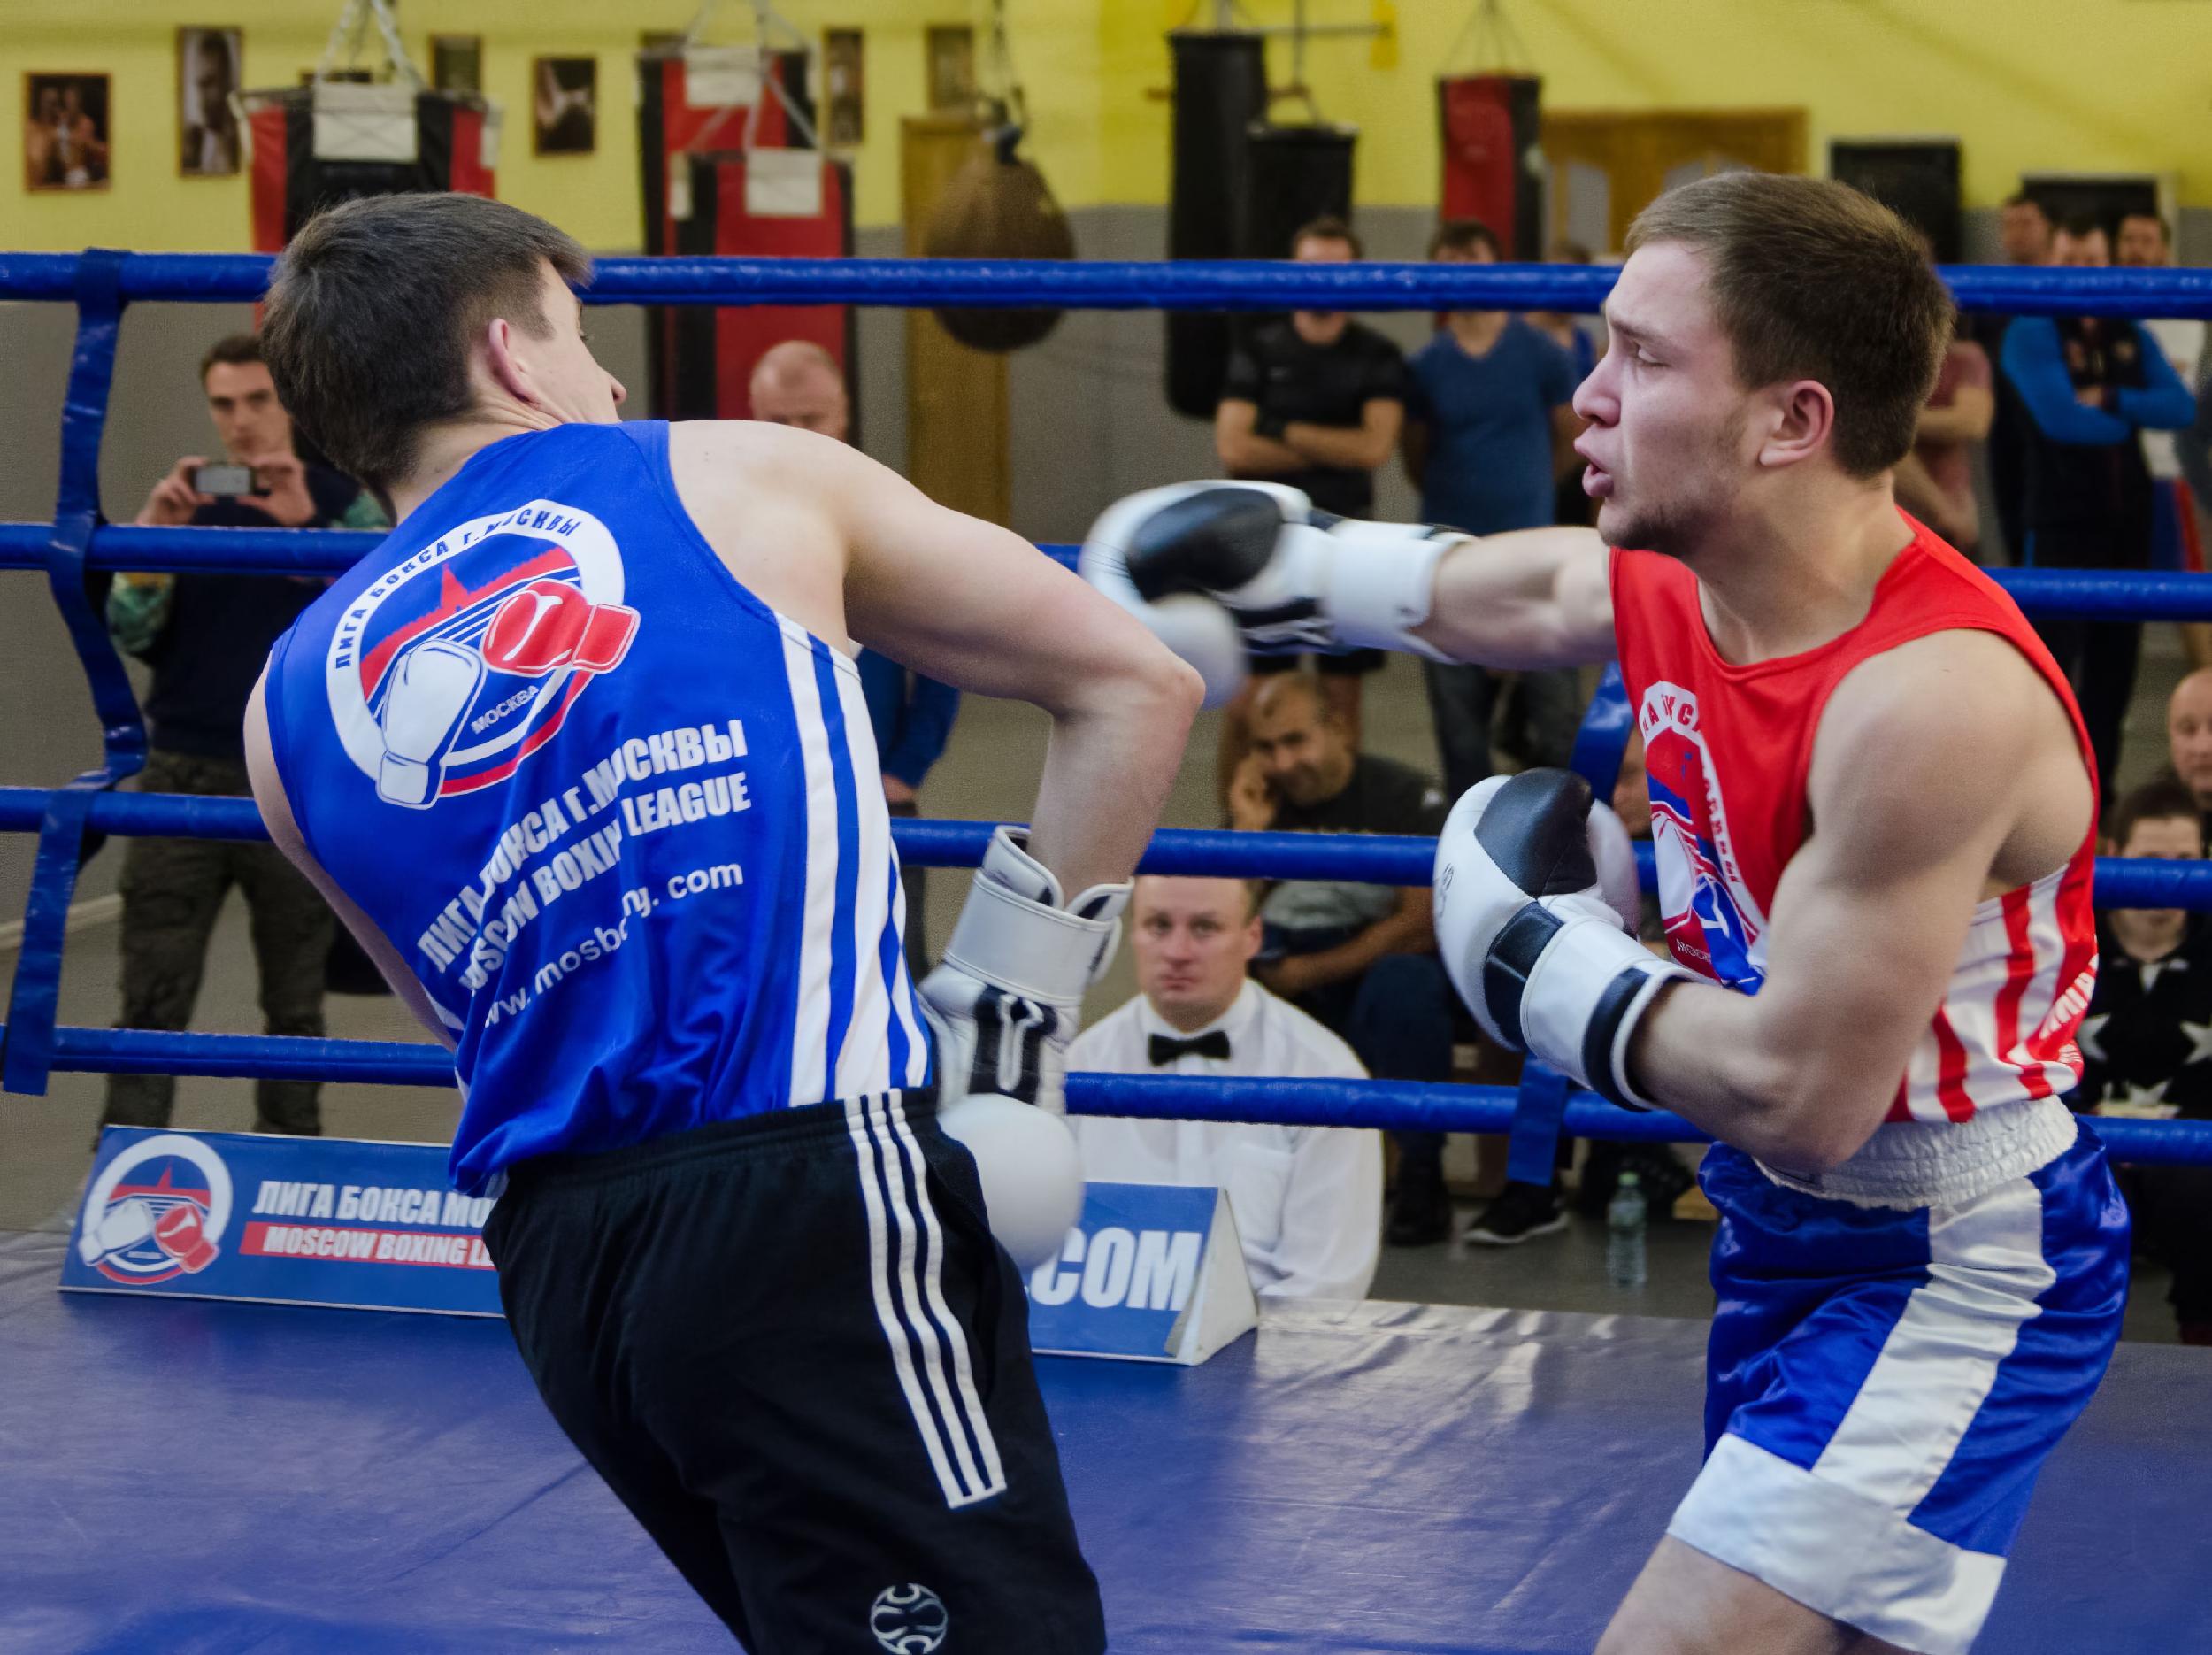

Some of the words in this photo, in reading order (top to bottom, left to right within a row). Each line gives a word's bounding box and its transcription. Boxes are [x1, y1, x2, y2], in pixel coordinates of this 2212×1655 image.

[370, 541, 449, 598] БОКСА
[471, 685, 540, 735] МОСКВА
[621, 772, 752, 837] LEAGUE
[252, 1180, 334, 1219] ЛИГА
[335, 1184, 442, 1226] БОКСА
[263, 1226, 378, 1259] MOSCOW
[376, 1233, 469, 1266] BOXING
